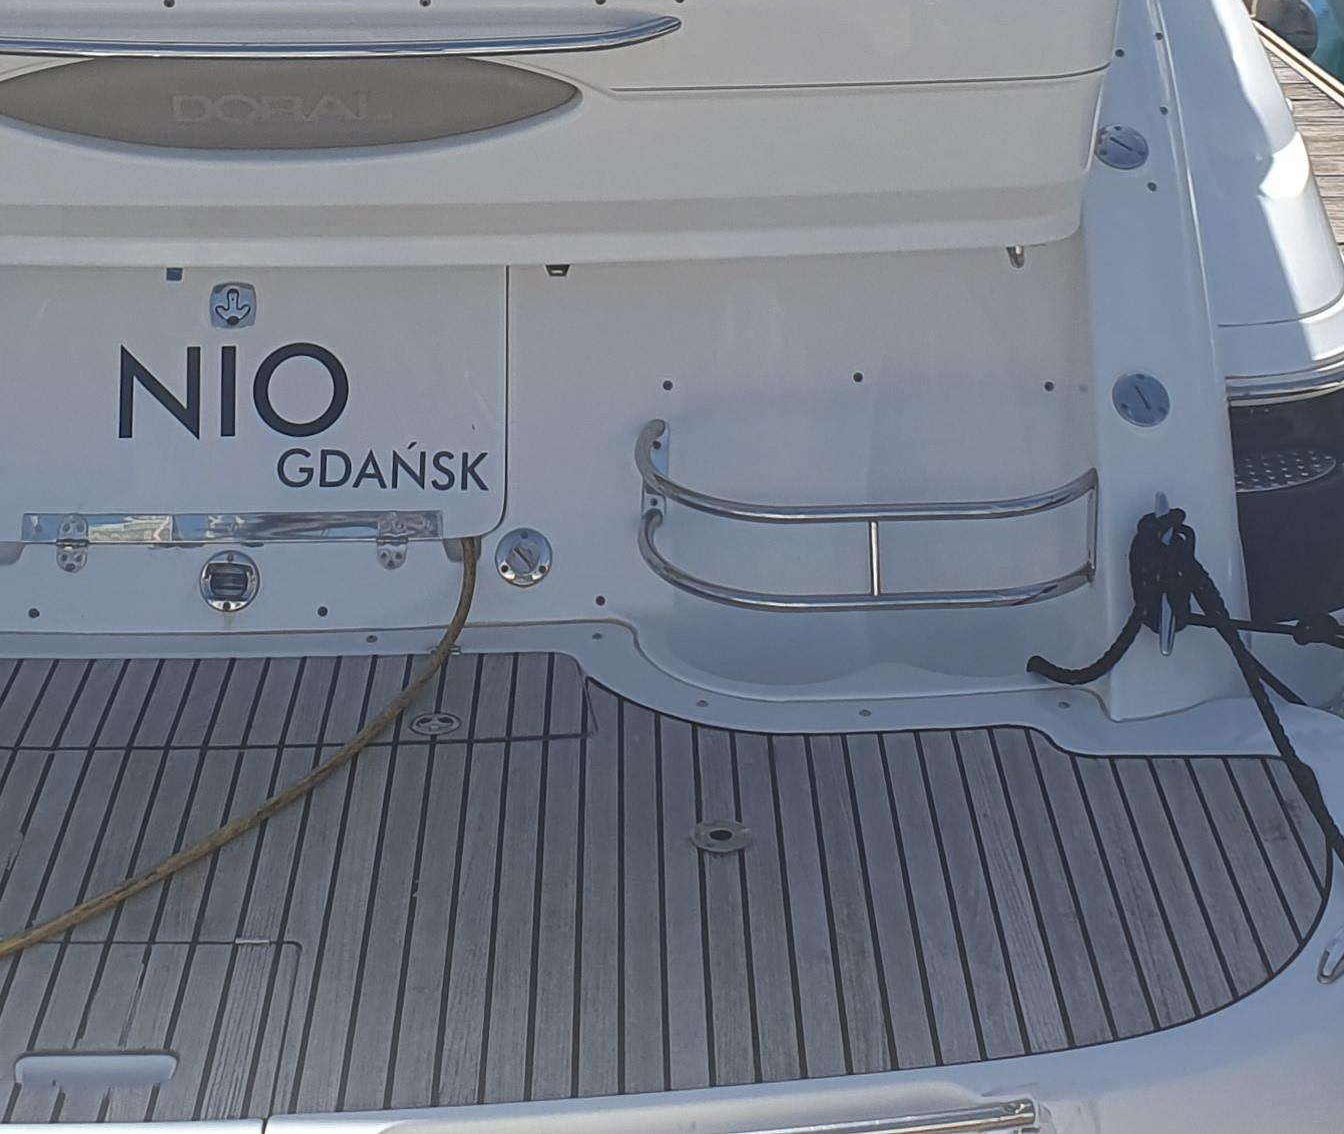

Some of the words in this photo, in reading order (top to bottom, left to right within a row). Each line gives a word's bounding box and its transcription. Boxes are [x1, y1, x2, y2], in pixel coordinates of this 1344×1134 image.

[171, 93, 392, 123] DORAL
[118, 341, 349, 441] NIO
[276, 441, 489, 492] GDAŃSK
